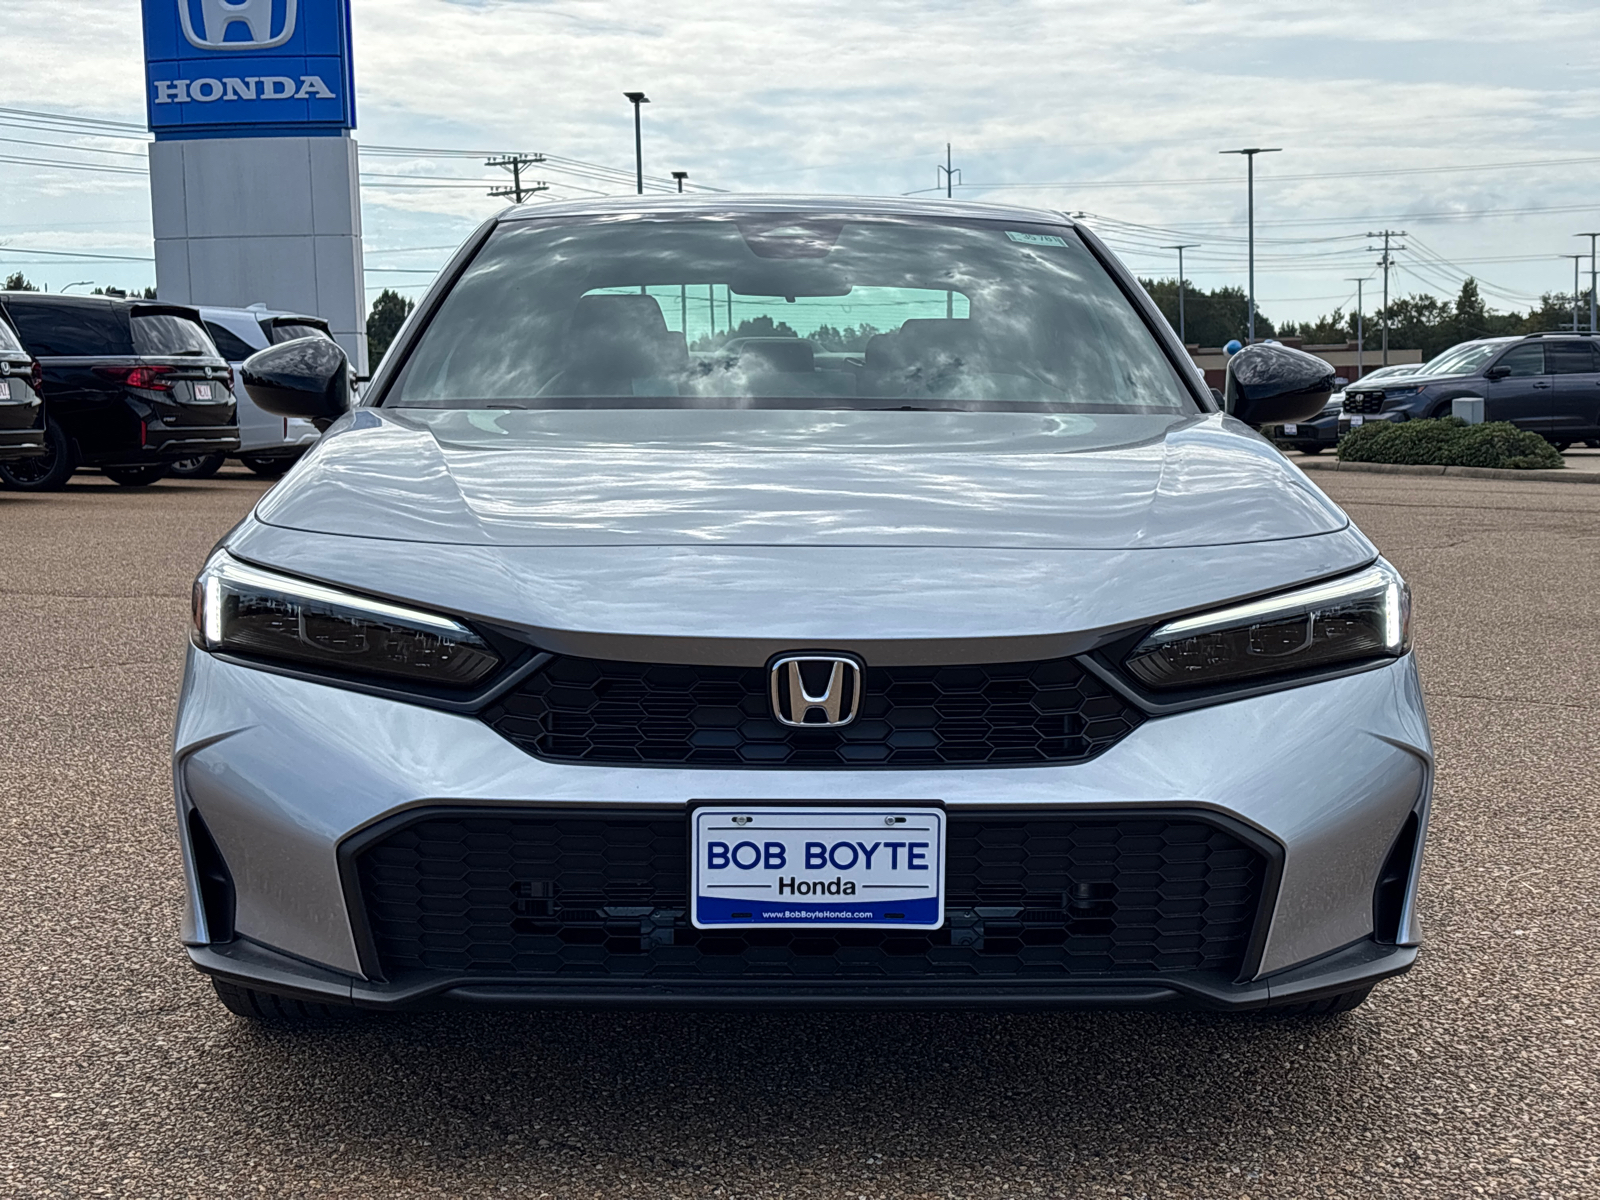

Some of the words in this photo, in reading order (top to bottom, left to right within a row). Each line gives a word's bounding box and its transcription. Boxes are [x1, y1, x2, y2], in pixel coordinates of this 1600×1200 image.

[154, 75, 336, 104] HONDA
[707, 841, 787, 870] BOB
[804, 841, 930, 870] BOYTE
[778, 876, 856, 895] Honda
[762, 910, 873, 919] www.BobBoyteHonda.com
